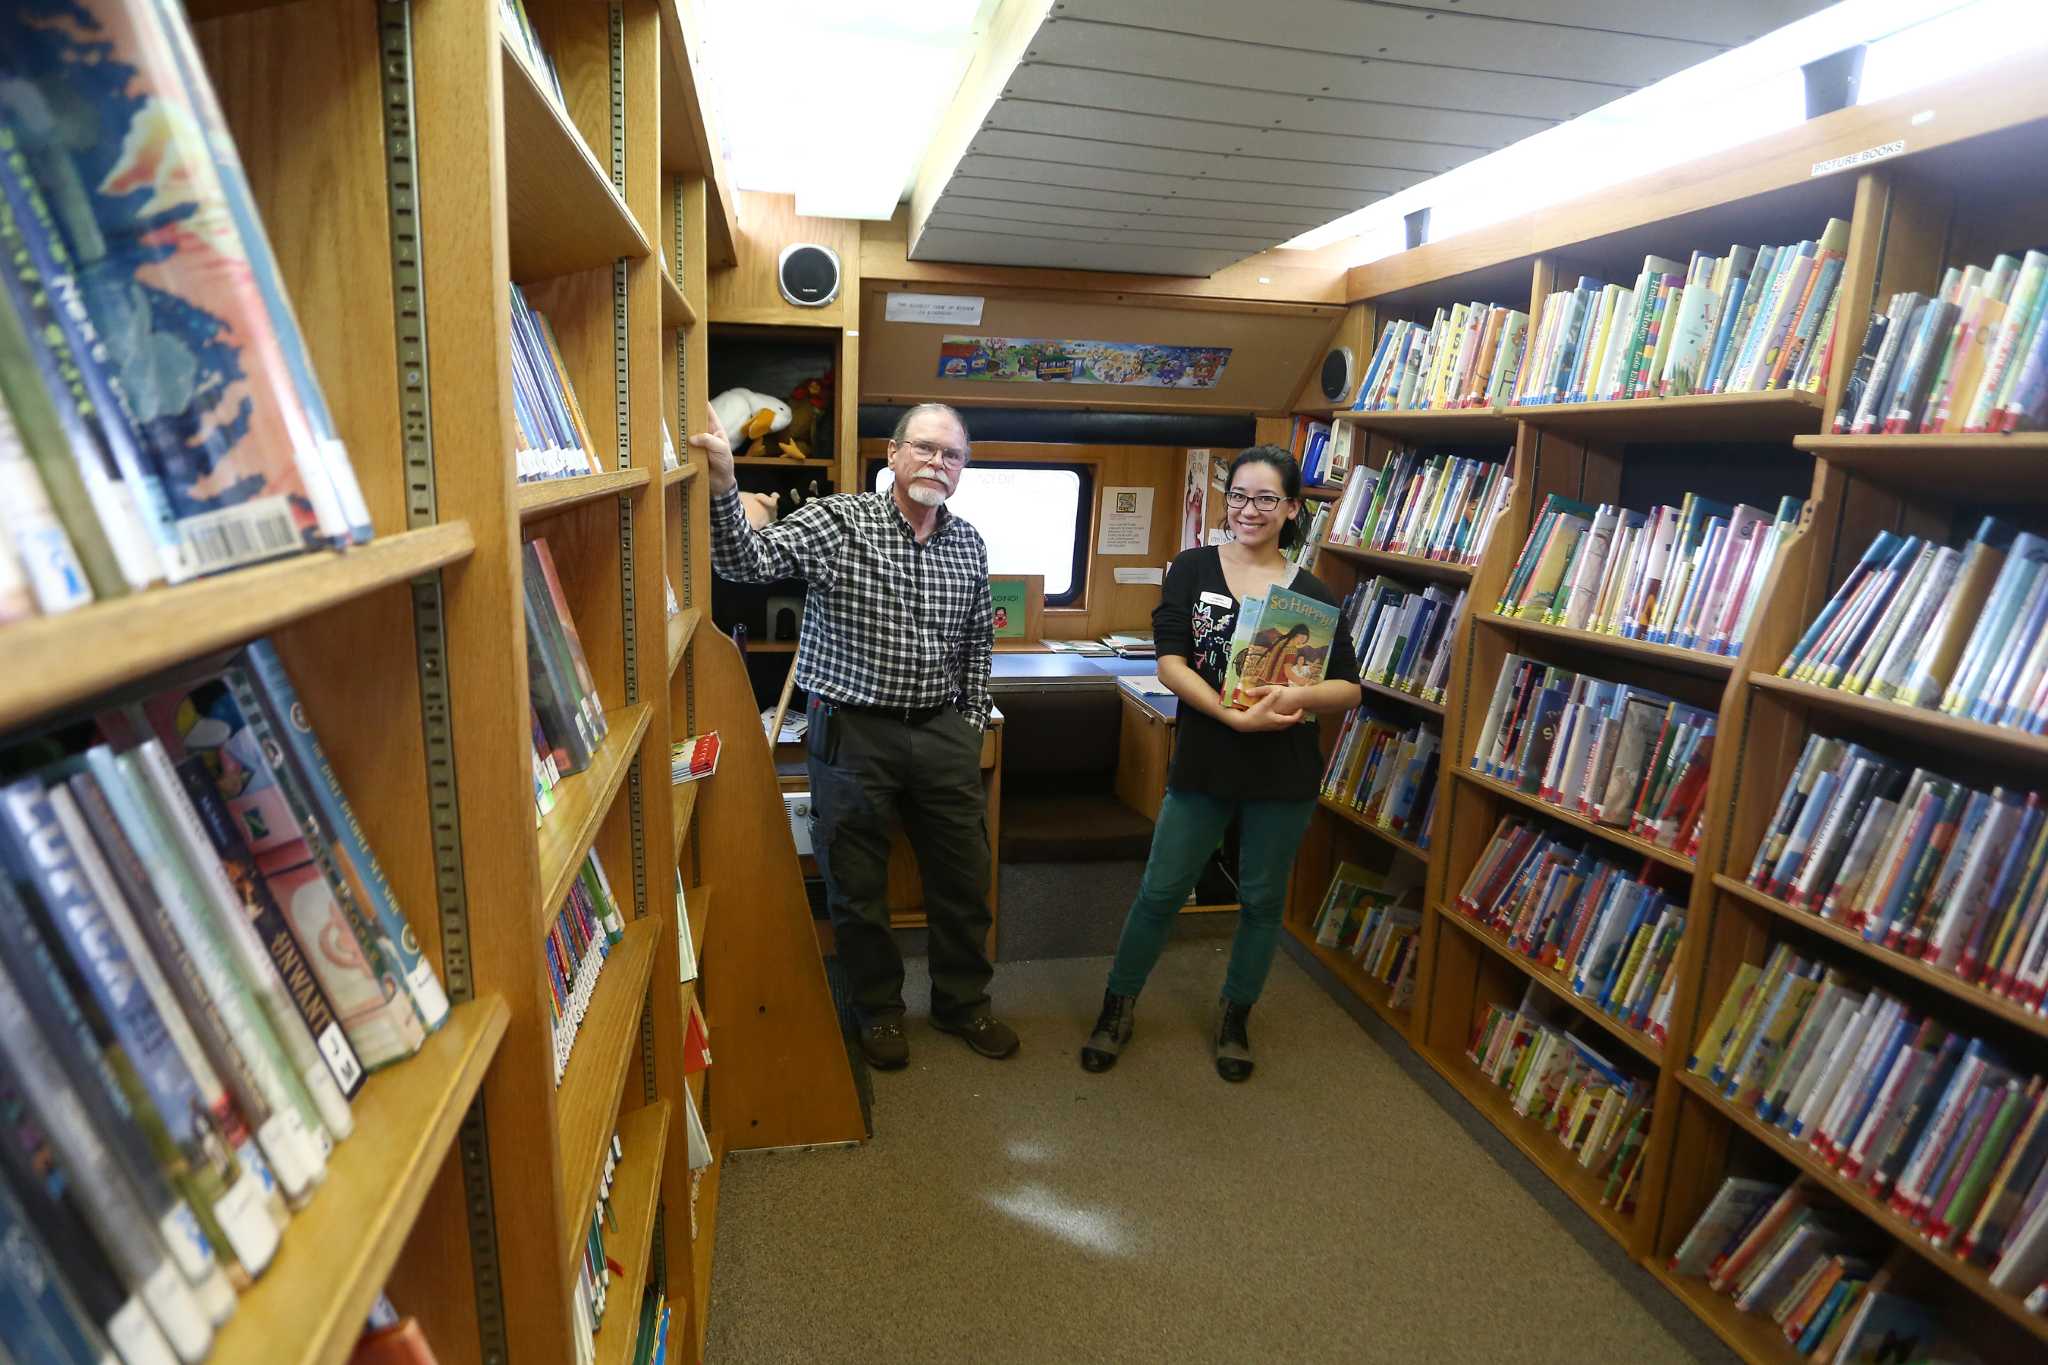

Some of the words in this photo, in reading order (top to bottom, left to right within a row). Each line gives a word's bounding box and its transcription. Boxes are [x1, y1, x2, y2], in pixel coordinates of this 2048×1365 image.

[1813, 156, 1858, 174] PICTURE
[1861, 142, 1903, 161] BOOKS
[1647, 280, 1660, 307] Holey
[1640, 310, 1652, 342] Moley
[1270, 592, 1288, 610] SO
[271, 931, 335, 1034] UNWANT
